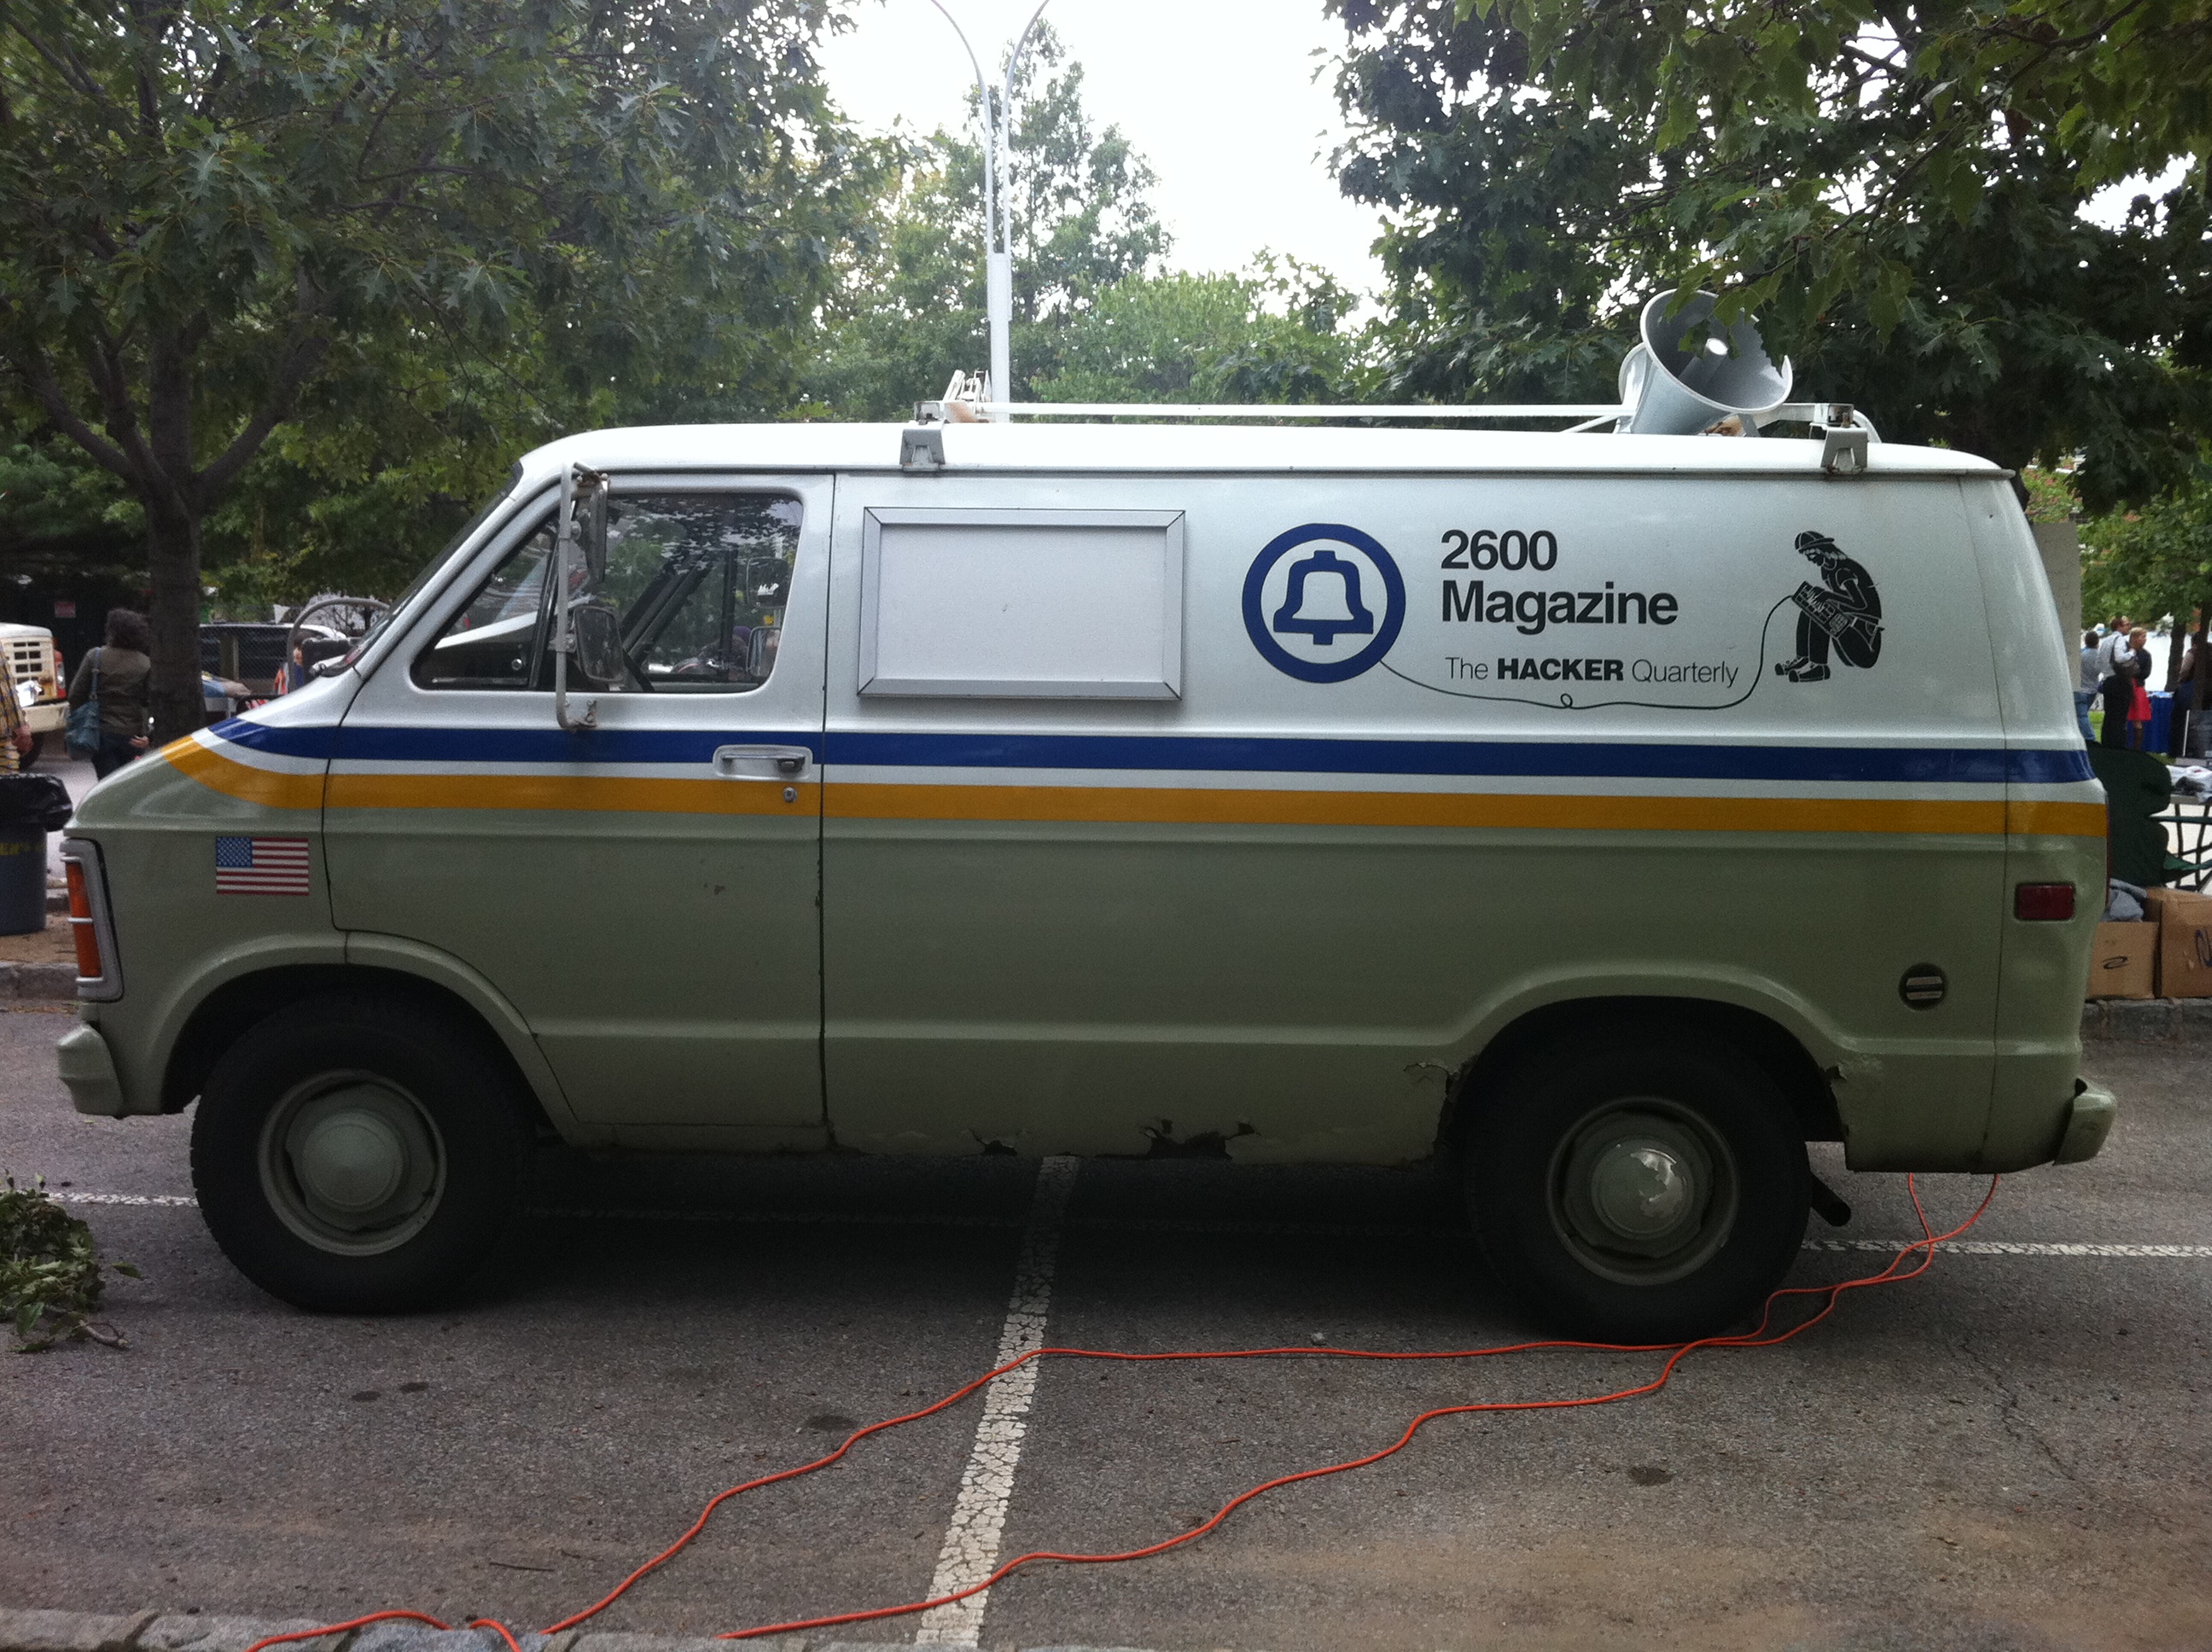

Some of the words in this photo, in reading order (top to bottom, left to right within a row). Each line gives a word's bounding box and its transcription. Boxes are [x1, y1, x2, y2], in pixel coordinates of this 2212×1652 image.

[1441, 529, 1558, 571] 2600
[1442, 579, 1679, 636] Magazine
[1445, 656, 1488, 680] The
[1497, 657, 1624, 682] HACKER
[1632, 659, 1739, 689] Quarterly
